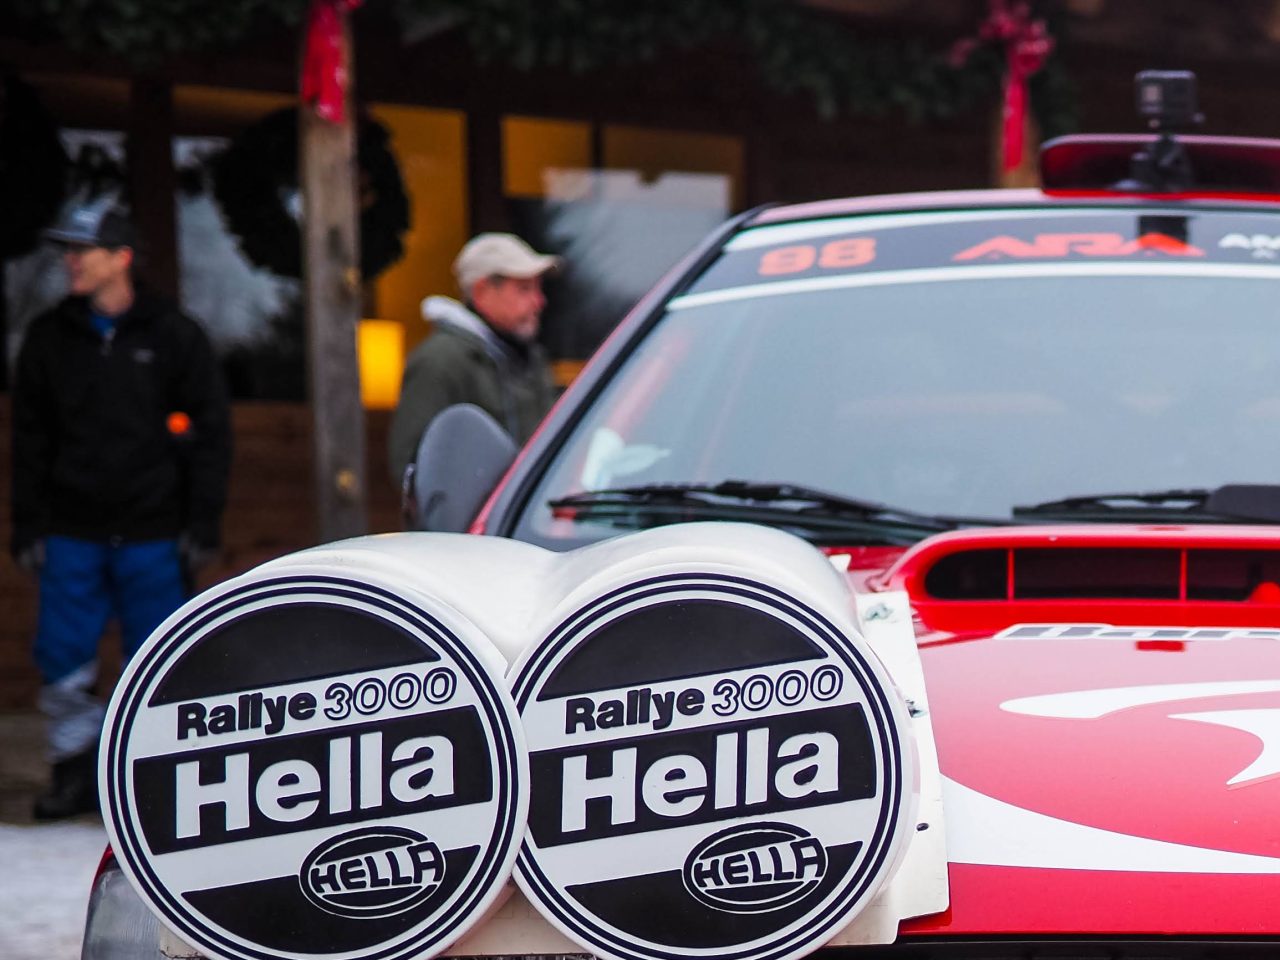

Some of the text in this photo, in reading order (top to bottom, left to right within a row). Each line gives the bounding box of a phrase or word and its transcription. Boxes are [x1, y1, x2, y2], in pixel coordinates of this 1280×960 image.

[952, 232, 1206, 262] ARA
[177, 667, 458, 740] Rallye 3000
[565, 664, 844, 735] Rallye 3000
[176, 731, 455, 840] Hella
[561, 727, 840, 834] Hella
[309, 841, 444, 893] HELLA
[695, 837, 828, 889] HELLA
